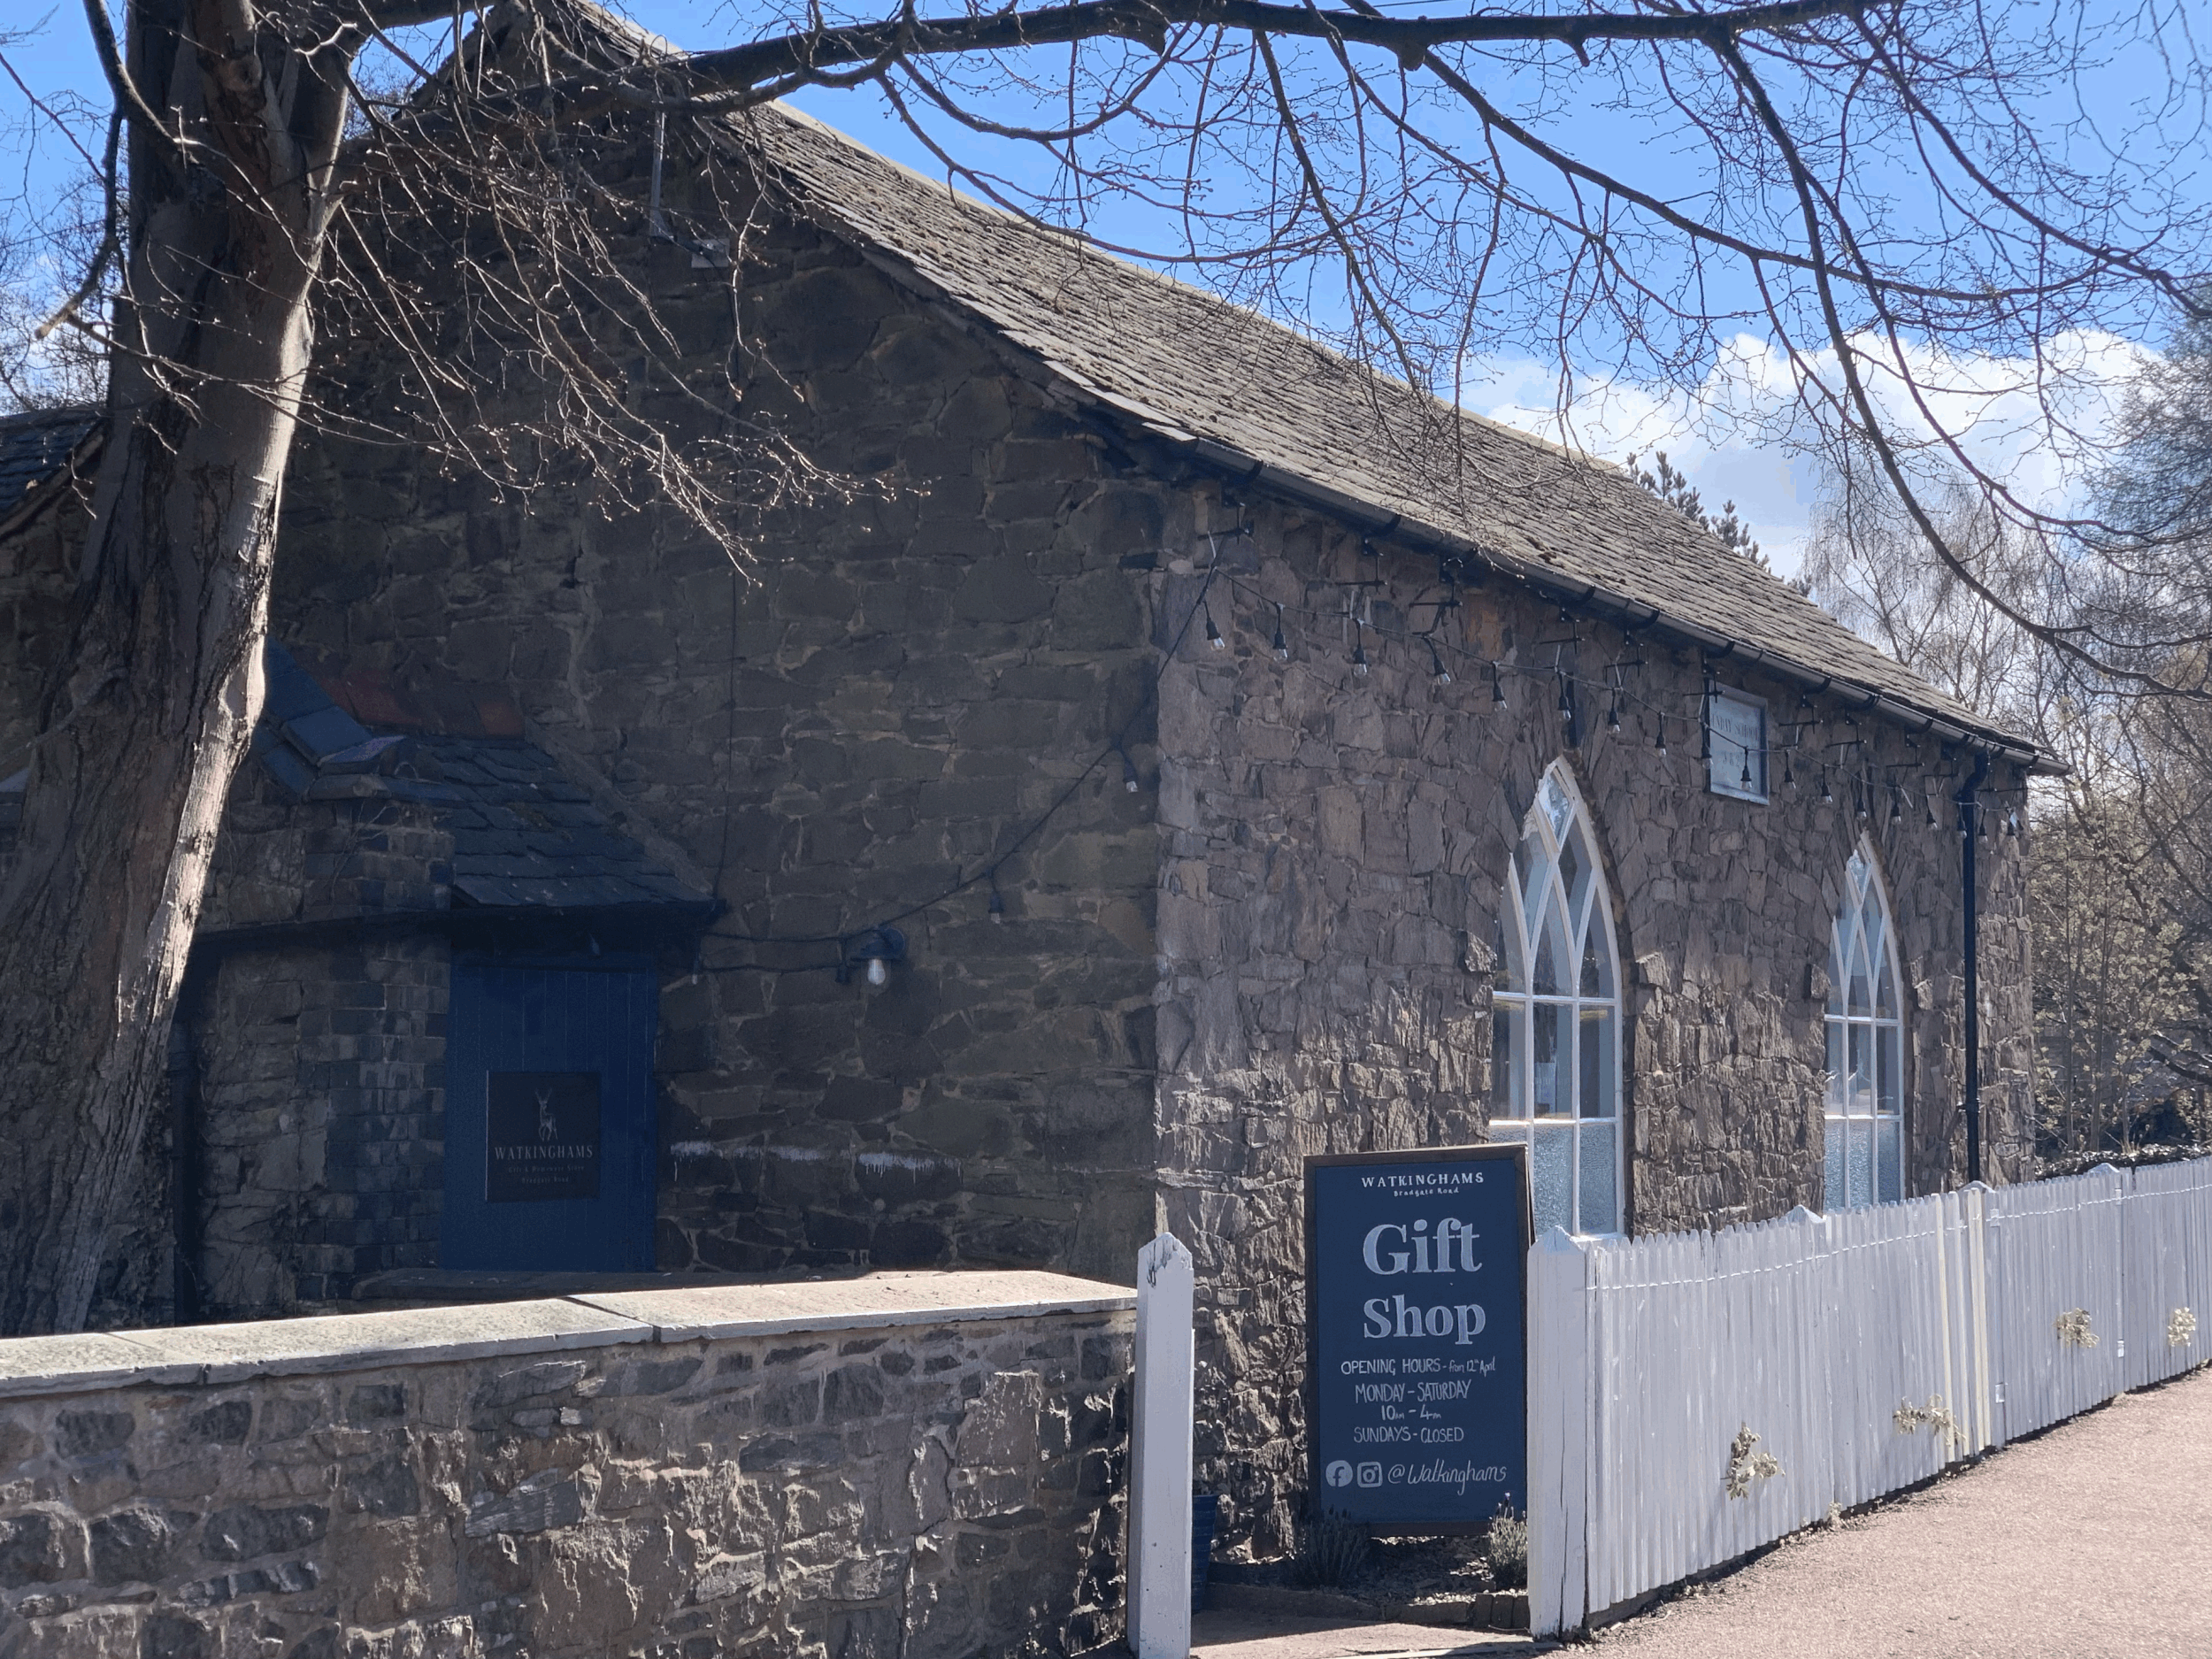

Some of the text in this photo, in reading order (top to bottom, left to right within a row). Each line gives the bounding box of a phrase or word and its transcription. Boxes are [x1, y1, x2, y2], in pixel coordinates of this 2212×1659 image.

[494, 1144, 594, 1161] WATKINGHAMS
[1361, 1171, 1485, 1188] WATKINGHAMS
[1393, 1188, 1434, 1197] Bradgate
[1363, 1217, 1483, 1275] Gift
[1363, 1294, 1486, 1345] Shop
[1340, 1358, 1396, 1376] OPENING
[1402, 1357, 1441, 1373] HOURS
[1479, 1356, 1496, 1378] April
[1355, 1382, 1406, 1404] MONDAY
[1417, 1379, 1472, 1402] SATURDAY
[1353, 1425, 1411, 1443] SUNDAYS
[1420, 1426, 1464, 1444] CLOSED
